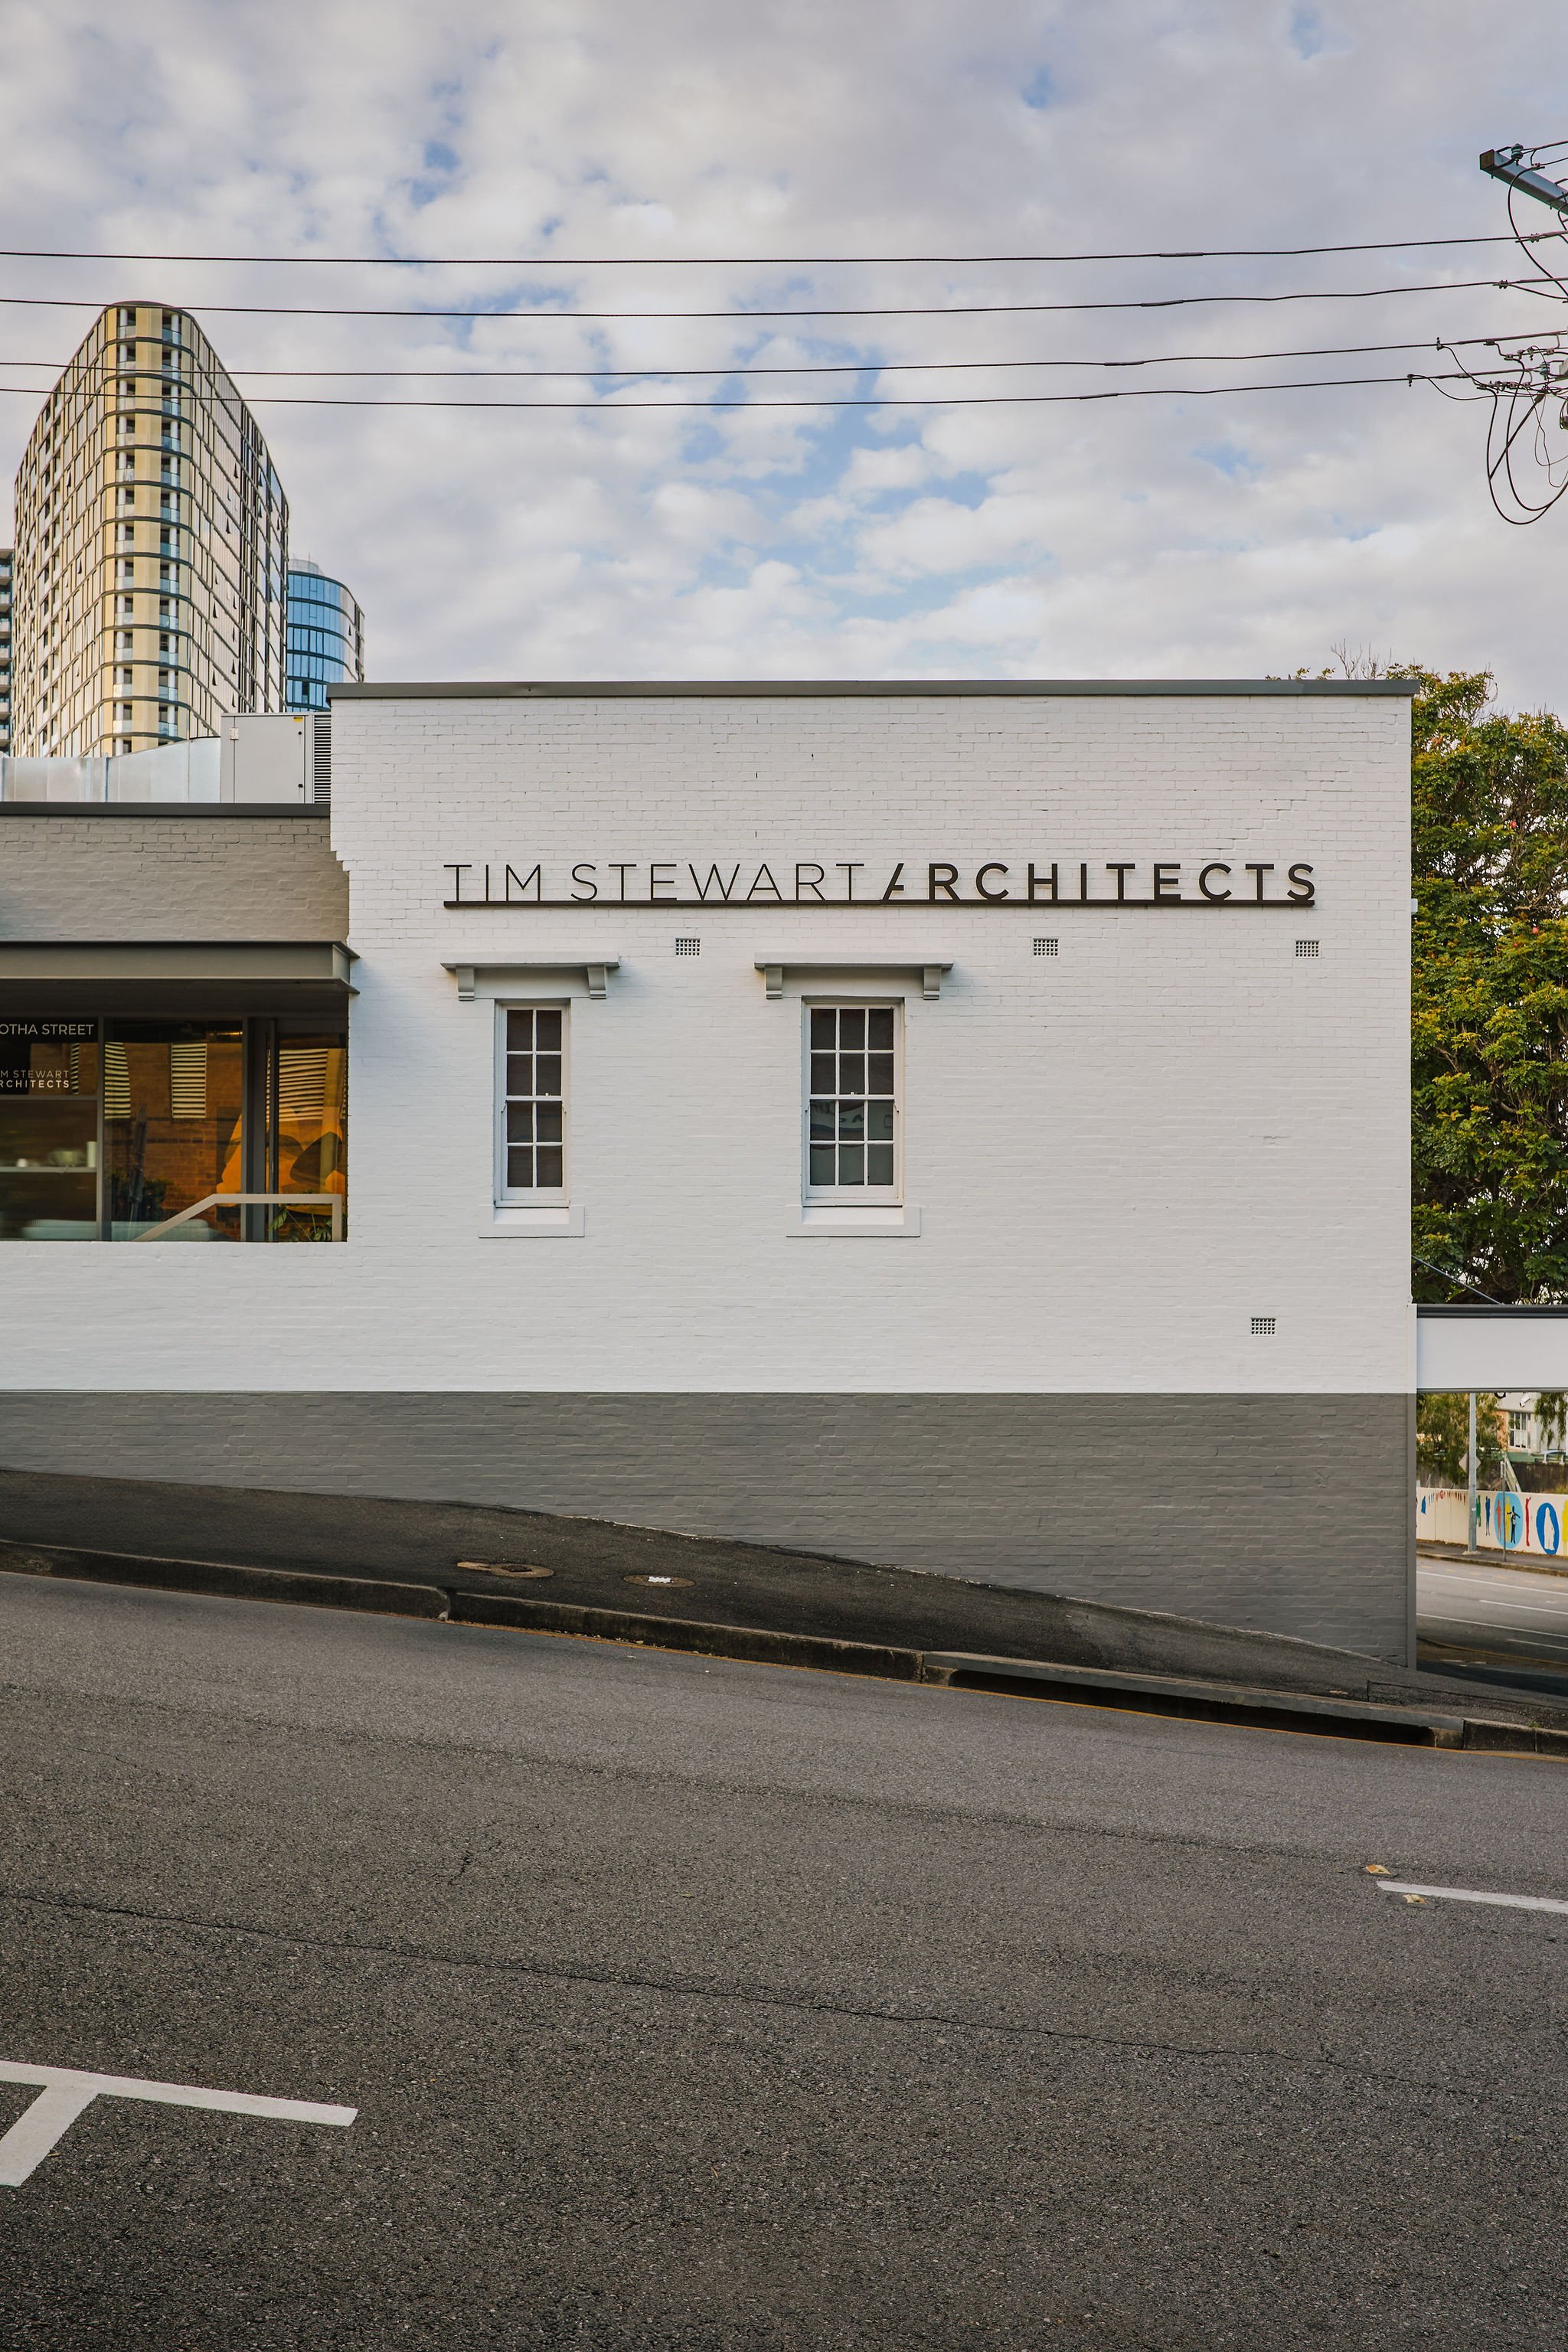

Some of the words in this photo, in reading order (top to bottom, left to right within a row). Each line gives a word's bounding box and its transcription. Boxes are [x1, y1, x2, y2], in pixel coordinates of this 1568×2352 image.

[444, 864, 541, 901] TIM
[570, 863, 864, 901] STEWART
[882, 863, 1315, 901] ARCHITECTS
[41, 1024, 95, 1035] STREET
[13, 1070, 69, 1078] STEWART
